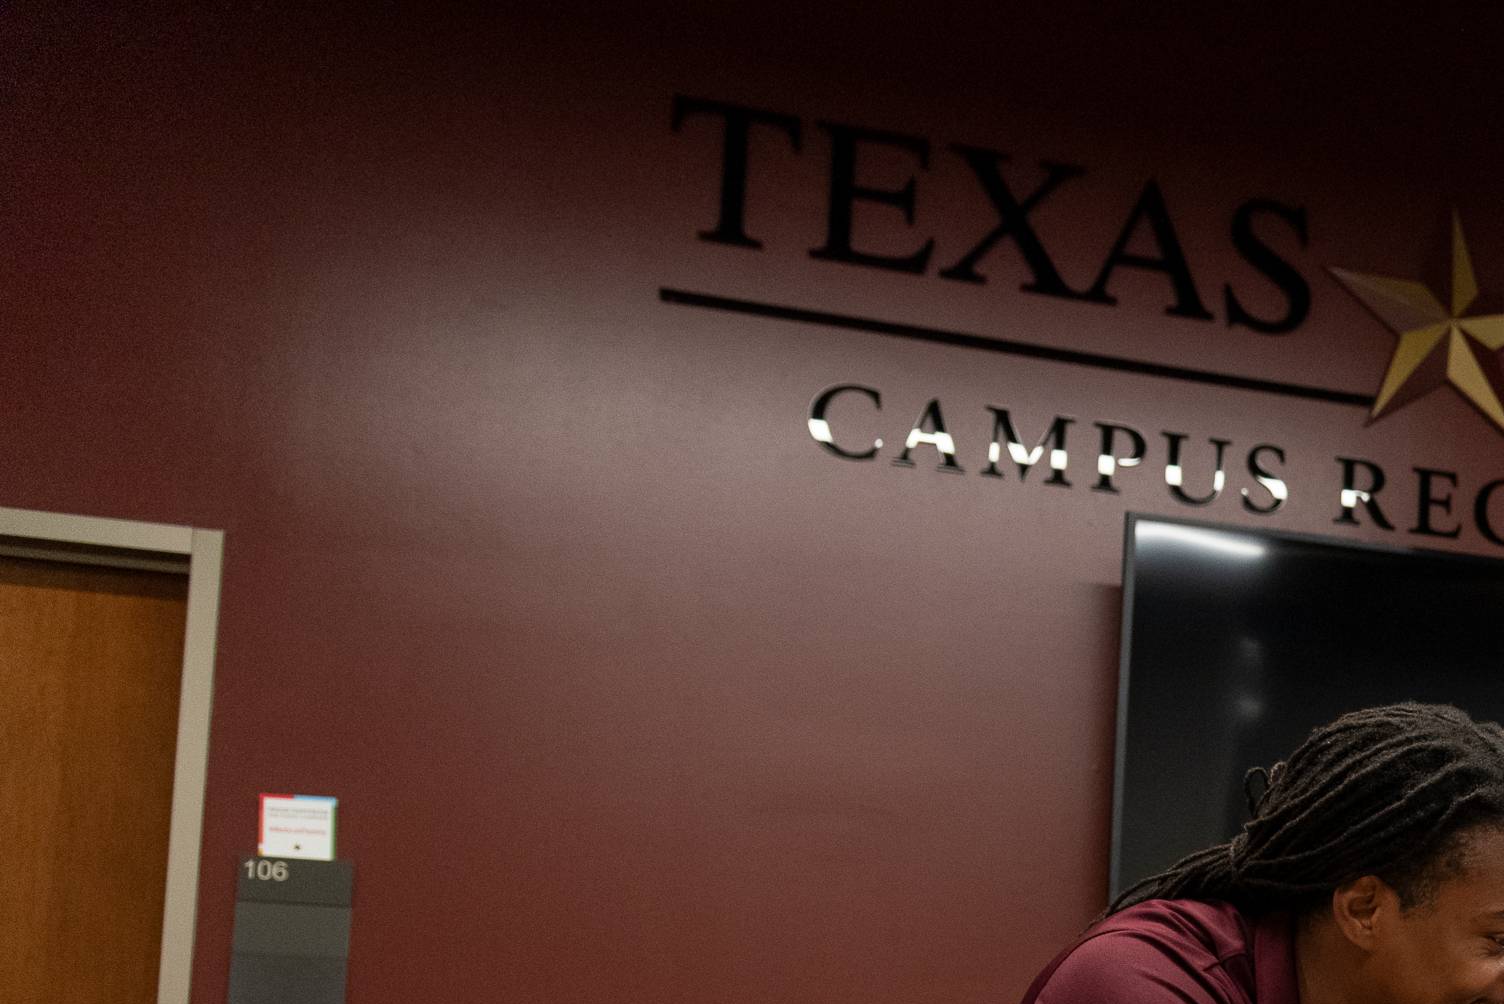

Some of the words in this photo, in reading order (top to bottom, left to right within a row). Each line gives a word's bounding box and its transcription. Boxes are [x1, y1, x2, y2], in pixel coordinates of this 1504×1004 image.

[671, 95, 1312, 335] TEXAS
[807, 384, 1290, 514] CAMPUS
[244, 860, 289, 882] 106
